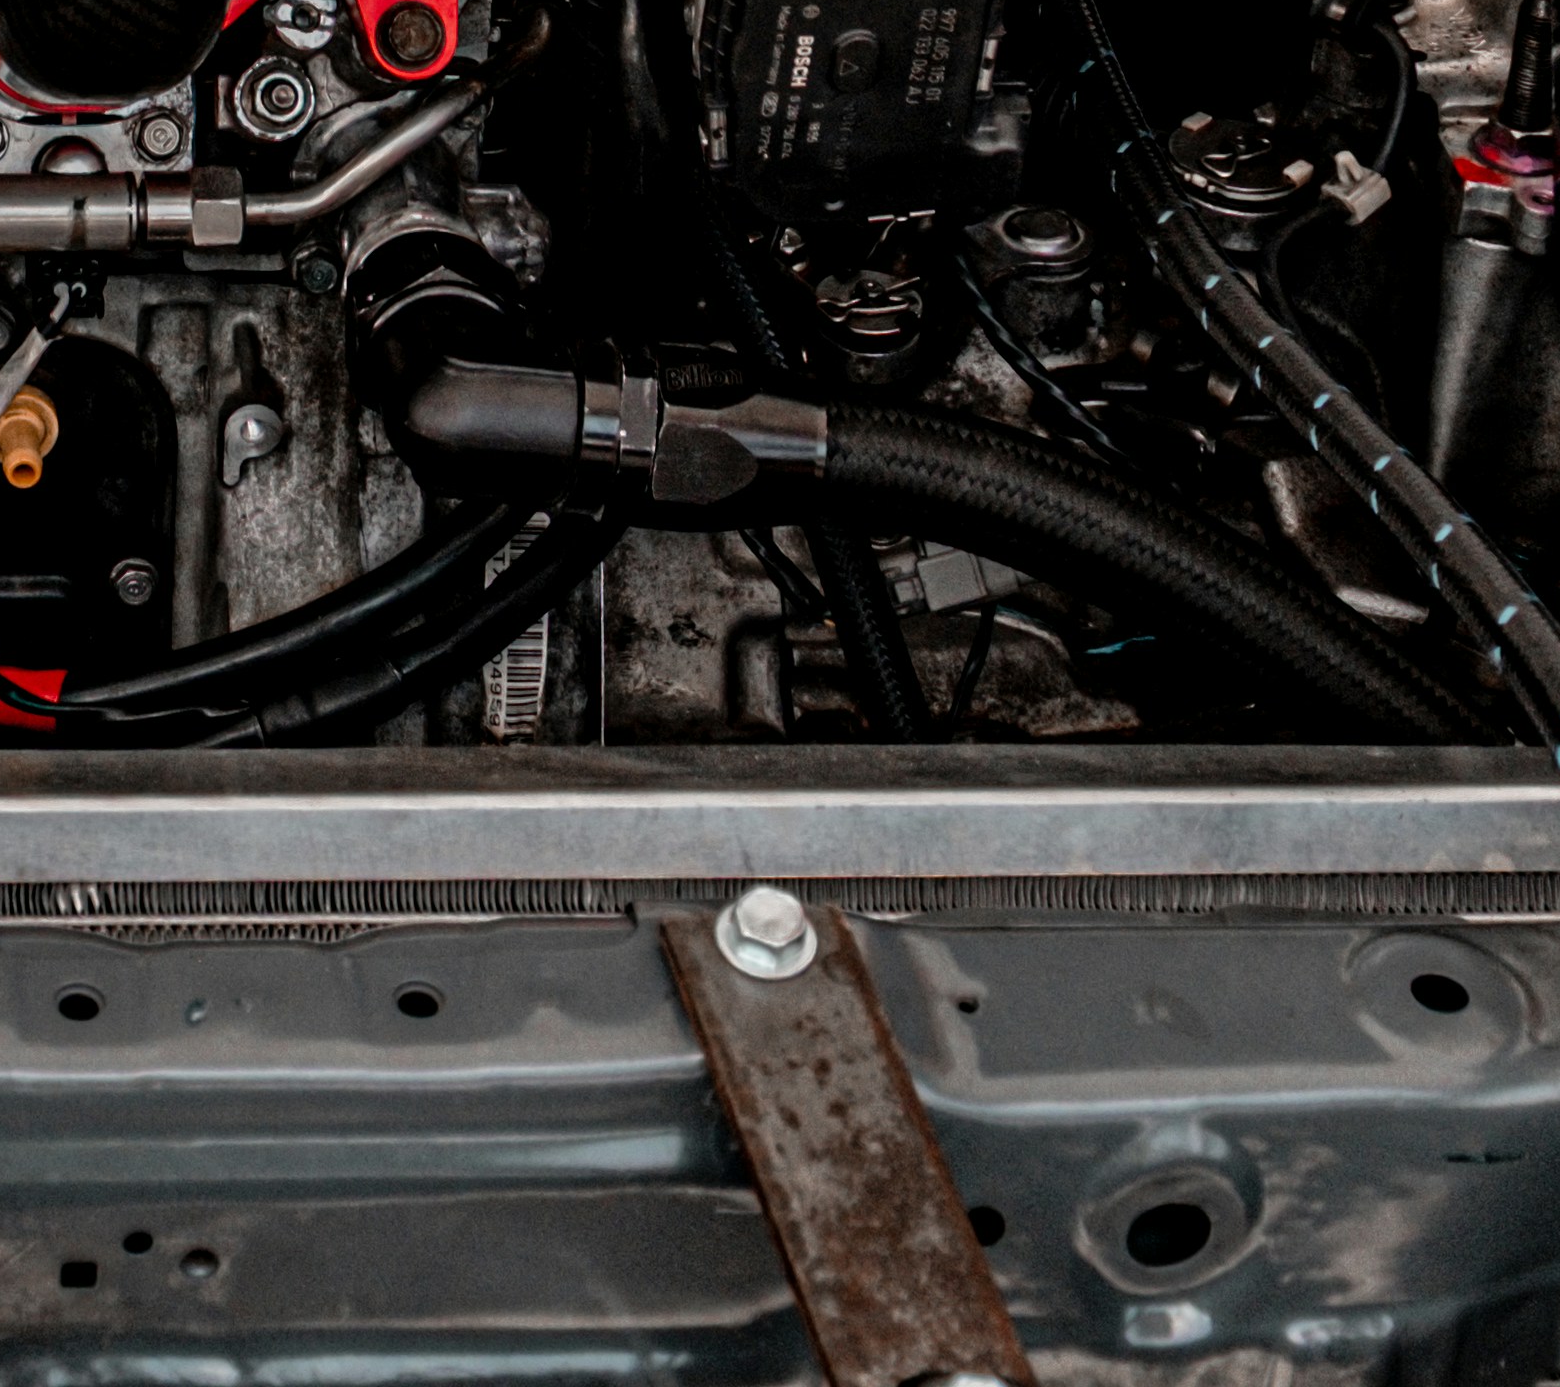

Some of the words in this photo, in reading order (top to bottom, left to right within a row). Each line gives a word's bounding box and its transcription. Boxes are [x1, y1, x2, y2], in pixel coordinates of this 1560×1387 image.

[917, 8, 936, 31] 022
[791, 35, 814, 88] BOSCH
[911, 59, 928, 80] 062
[664, 362, 745, 392] Billion
